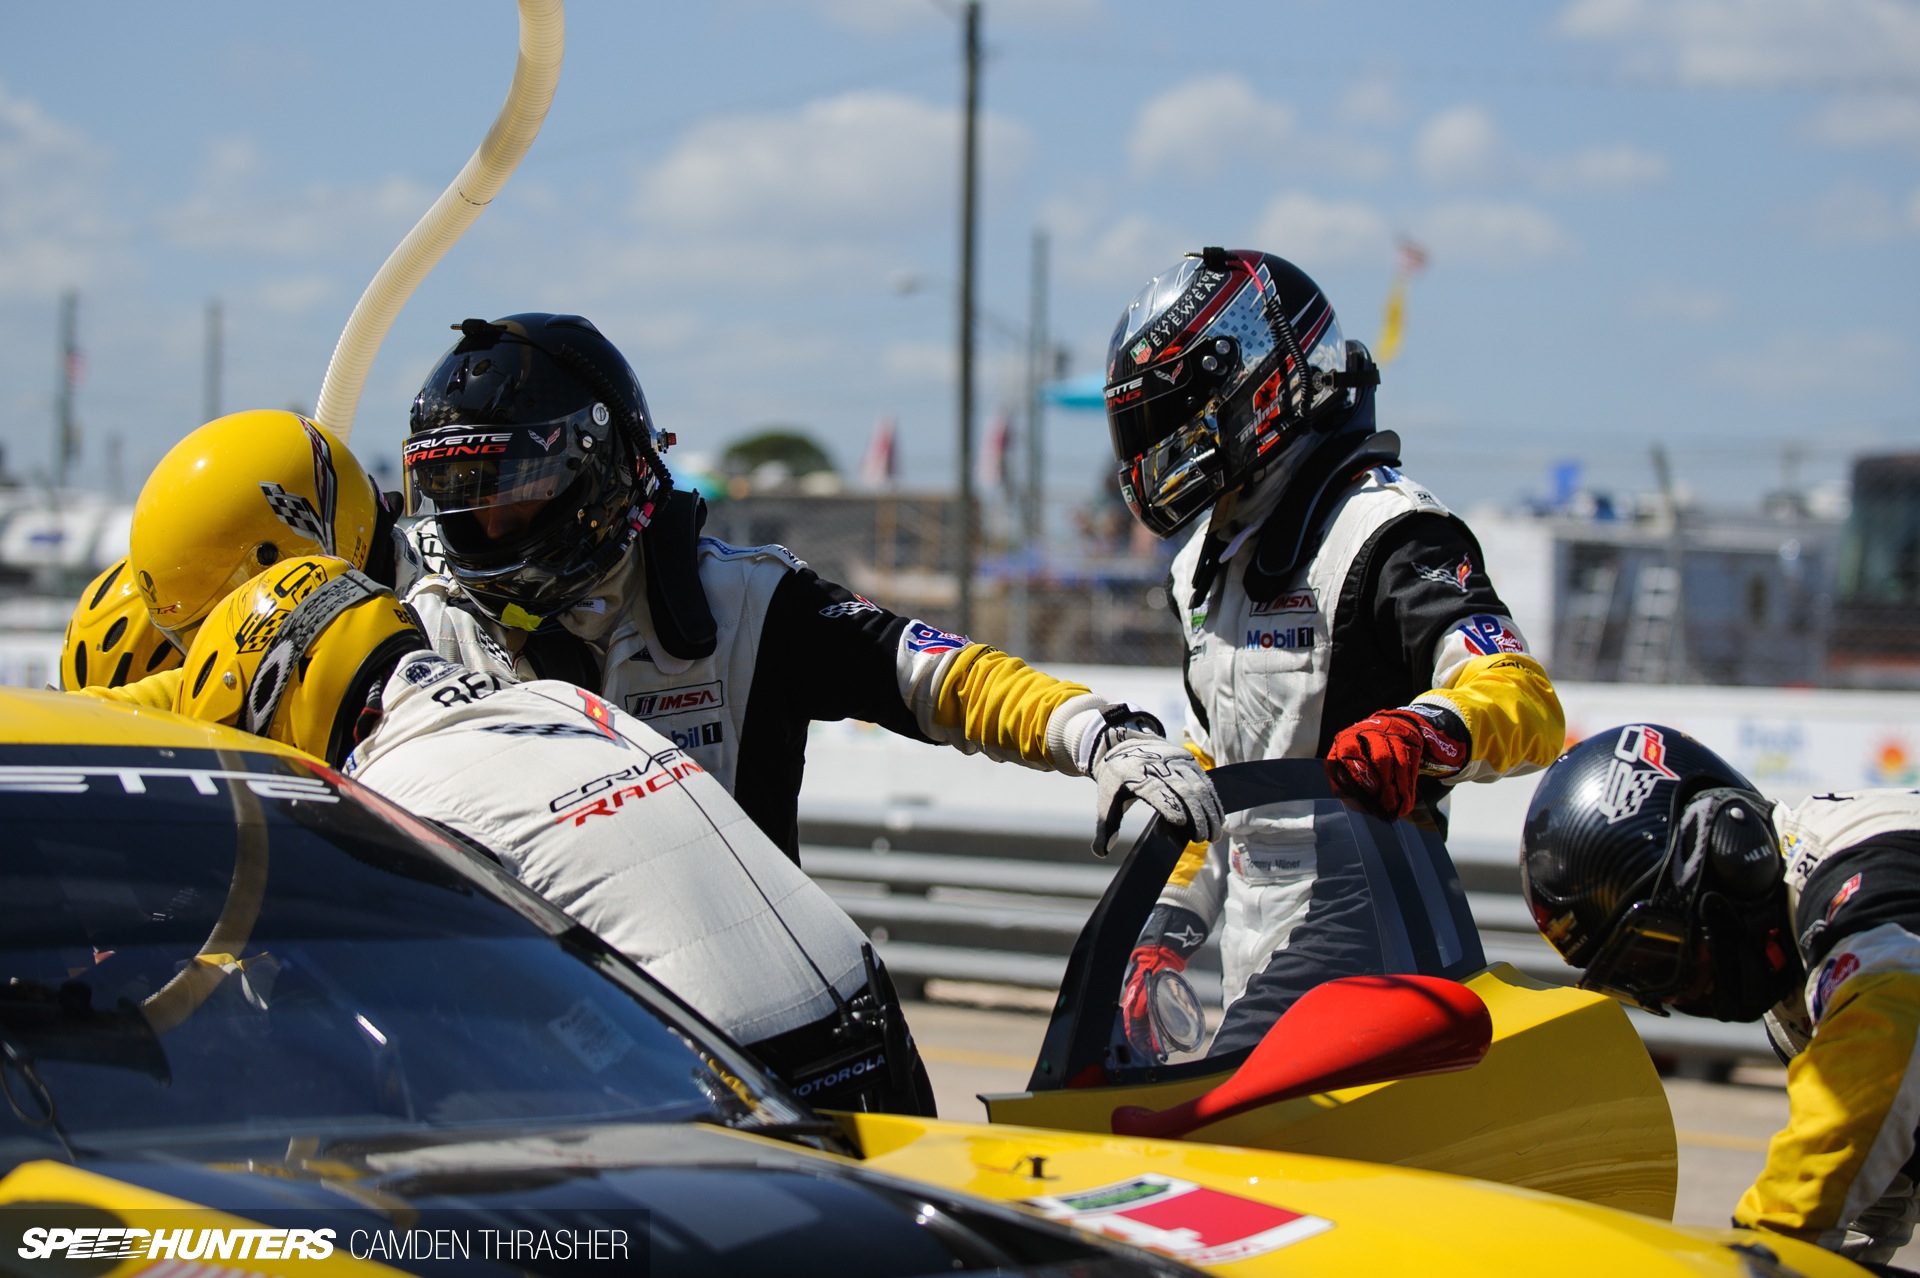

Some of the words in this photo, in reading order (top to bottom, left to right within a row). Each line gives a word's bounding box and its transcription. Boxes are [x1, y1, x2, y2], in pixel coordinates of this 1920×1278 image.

[1150, 270, 1214, 341] AVANT-GARDE
[1152, 272, 1225, 347] EYEWEAR
[404, 444, 508, 466] RACING
[1246, 628, 1295, 649] Mobil
[1300, 628, 1313, 647] 1
[658, 690, 714, 711] IMSA
[704, 723, 717, 744] 1
[1797, 852, 1820, 877] 21
